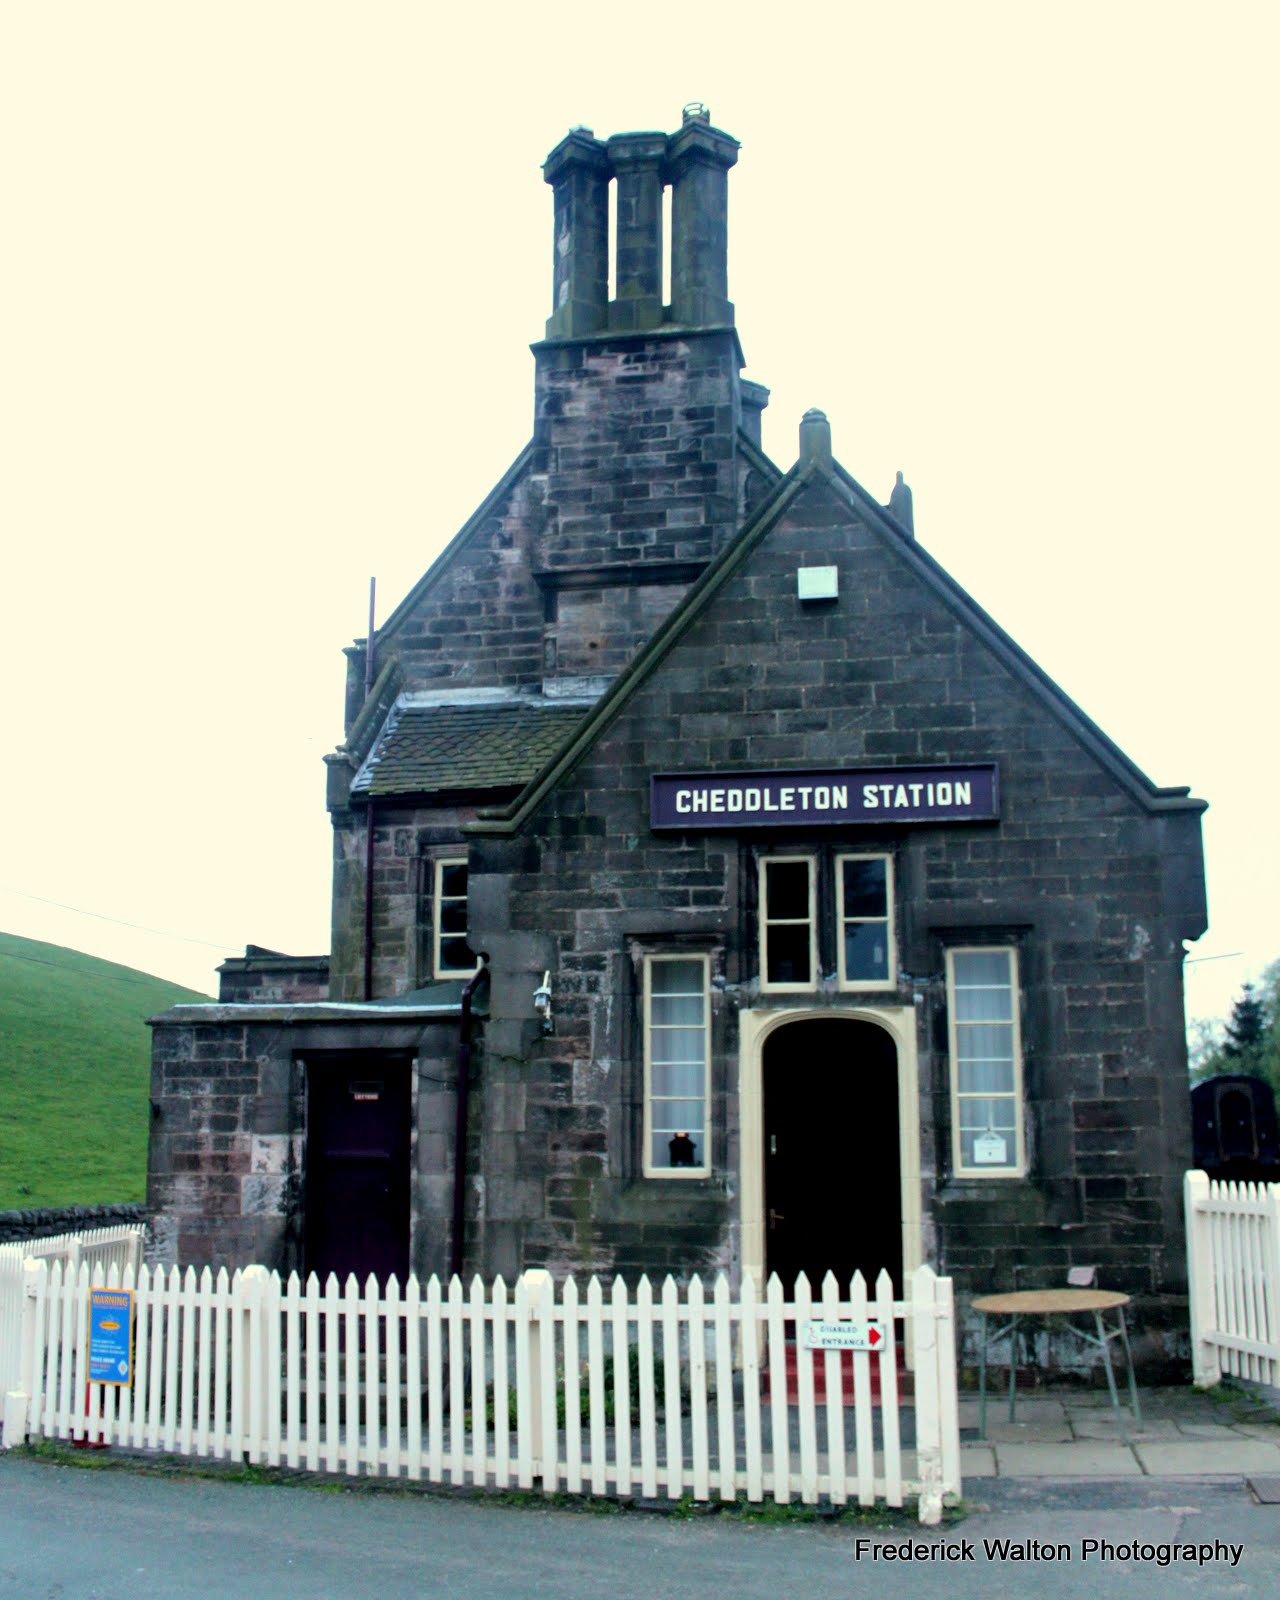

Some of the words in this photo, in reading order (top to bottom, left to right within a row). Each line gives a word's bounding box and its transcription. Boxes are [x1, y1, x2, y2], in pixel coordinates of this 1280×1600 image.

[675, 785, 848, 813] CHEDDLETON
[862, 781, 972, 809] STATION
[93, 1295, 128, 1307] WARNING
[821, 1337, 865, 1347] ENTRANCE
